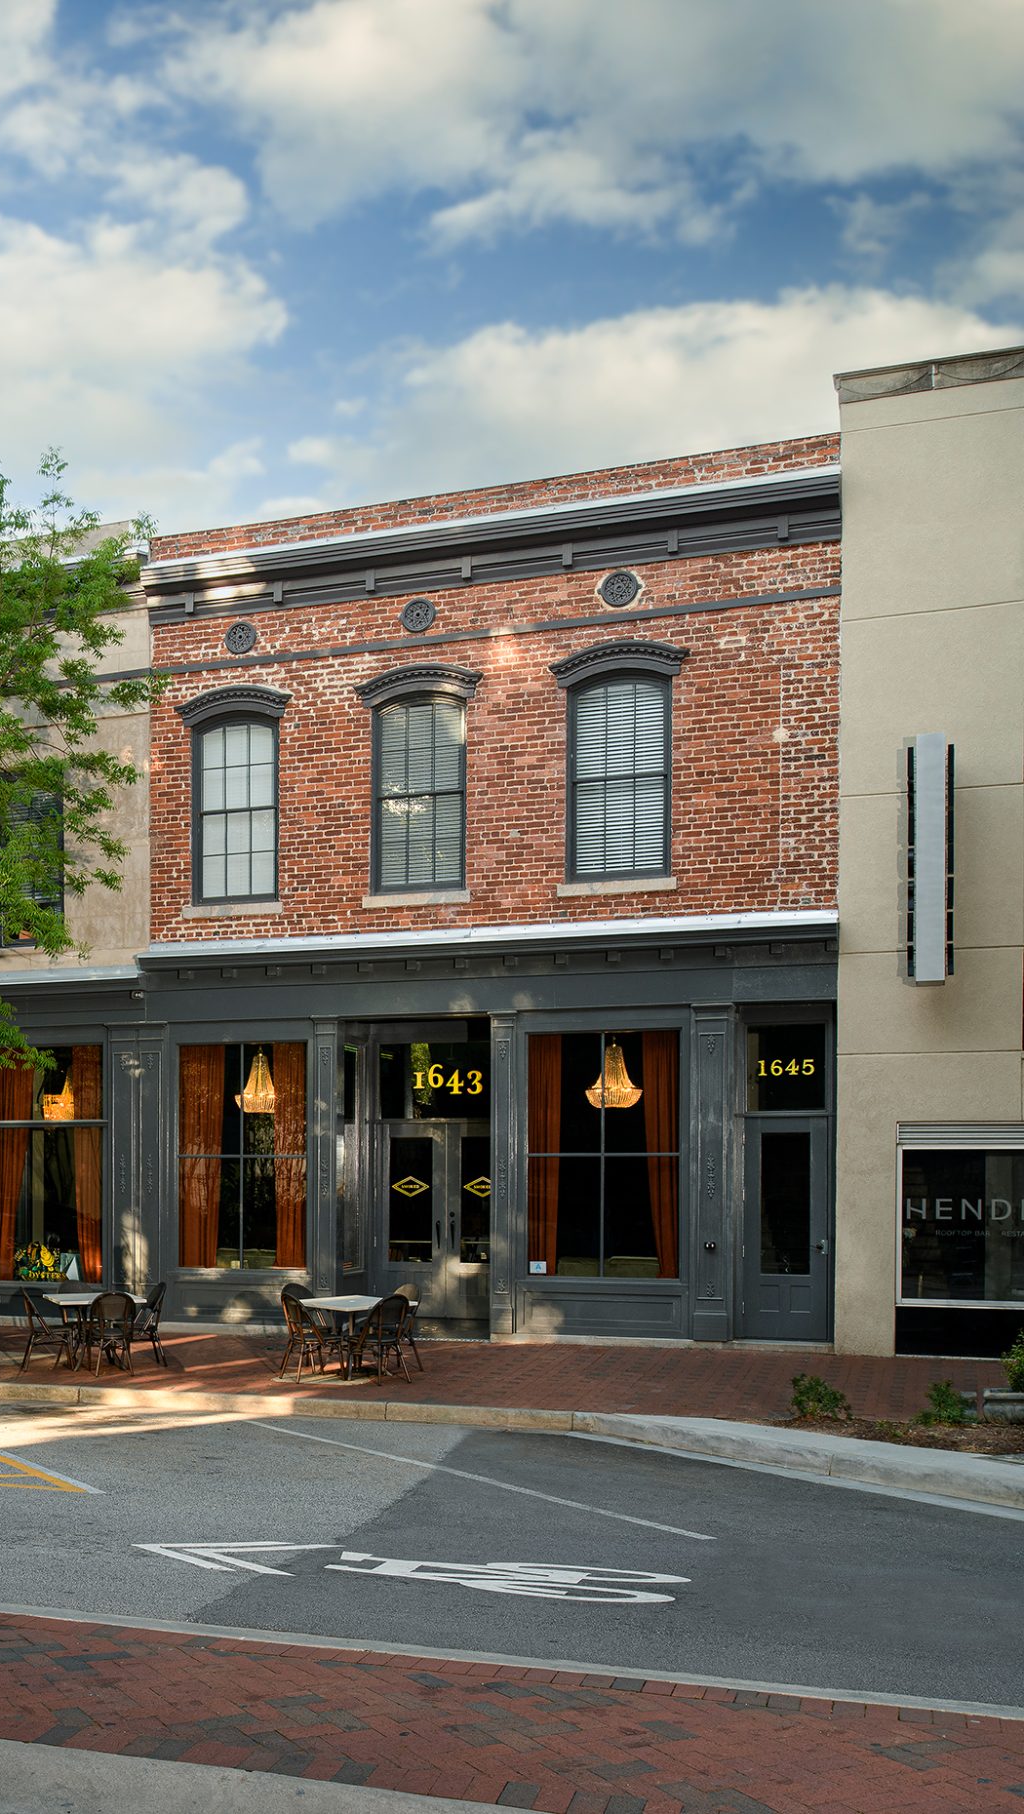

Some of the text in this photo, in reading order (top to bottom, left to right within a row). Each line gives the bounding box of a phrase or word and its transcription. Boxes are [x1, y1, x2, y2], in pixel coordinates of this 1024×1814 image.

[757, 1058, 815, 1076] 1645
[413, 1063, 483, 1095] 1643
[906, 1198, 1024, 1220] HEND
[28, 1270, 67, 1280] OYSTERS
